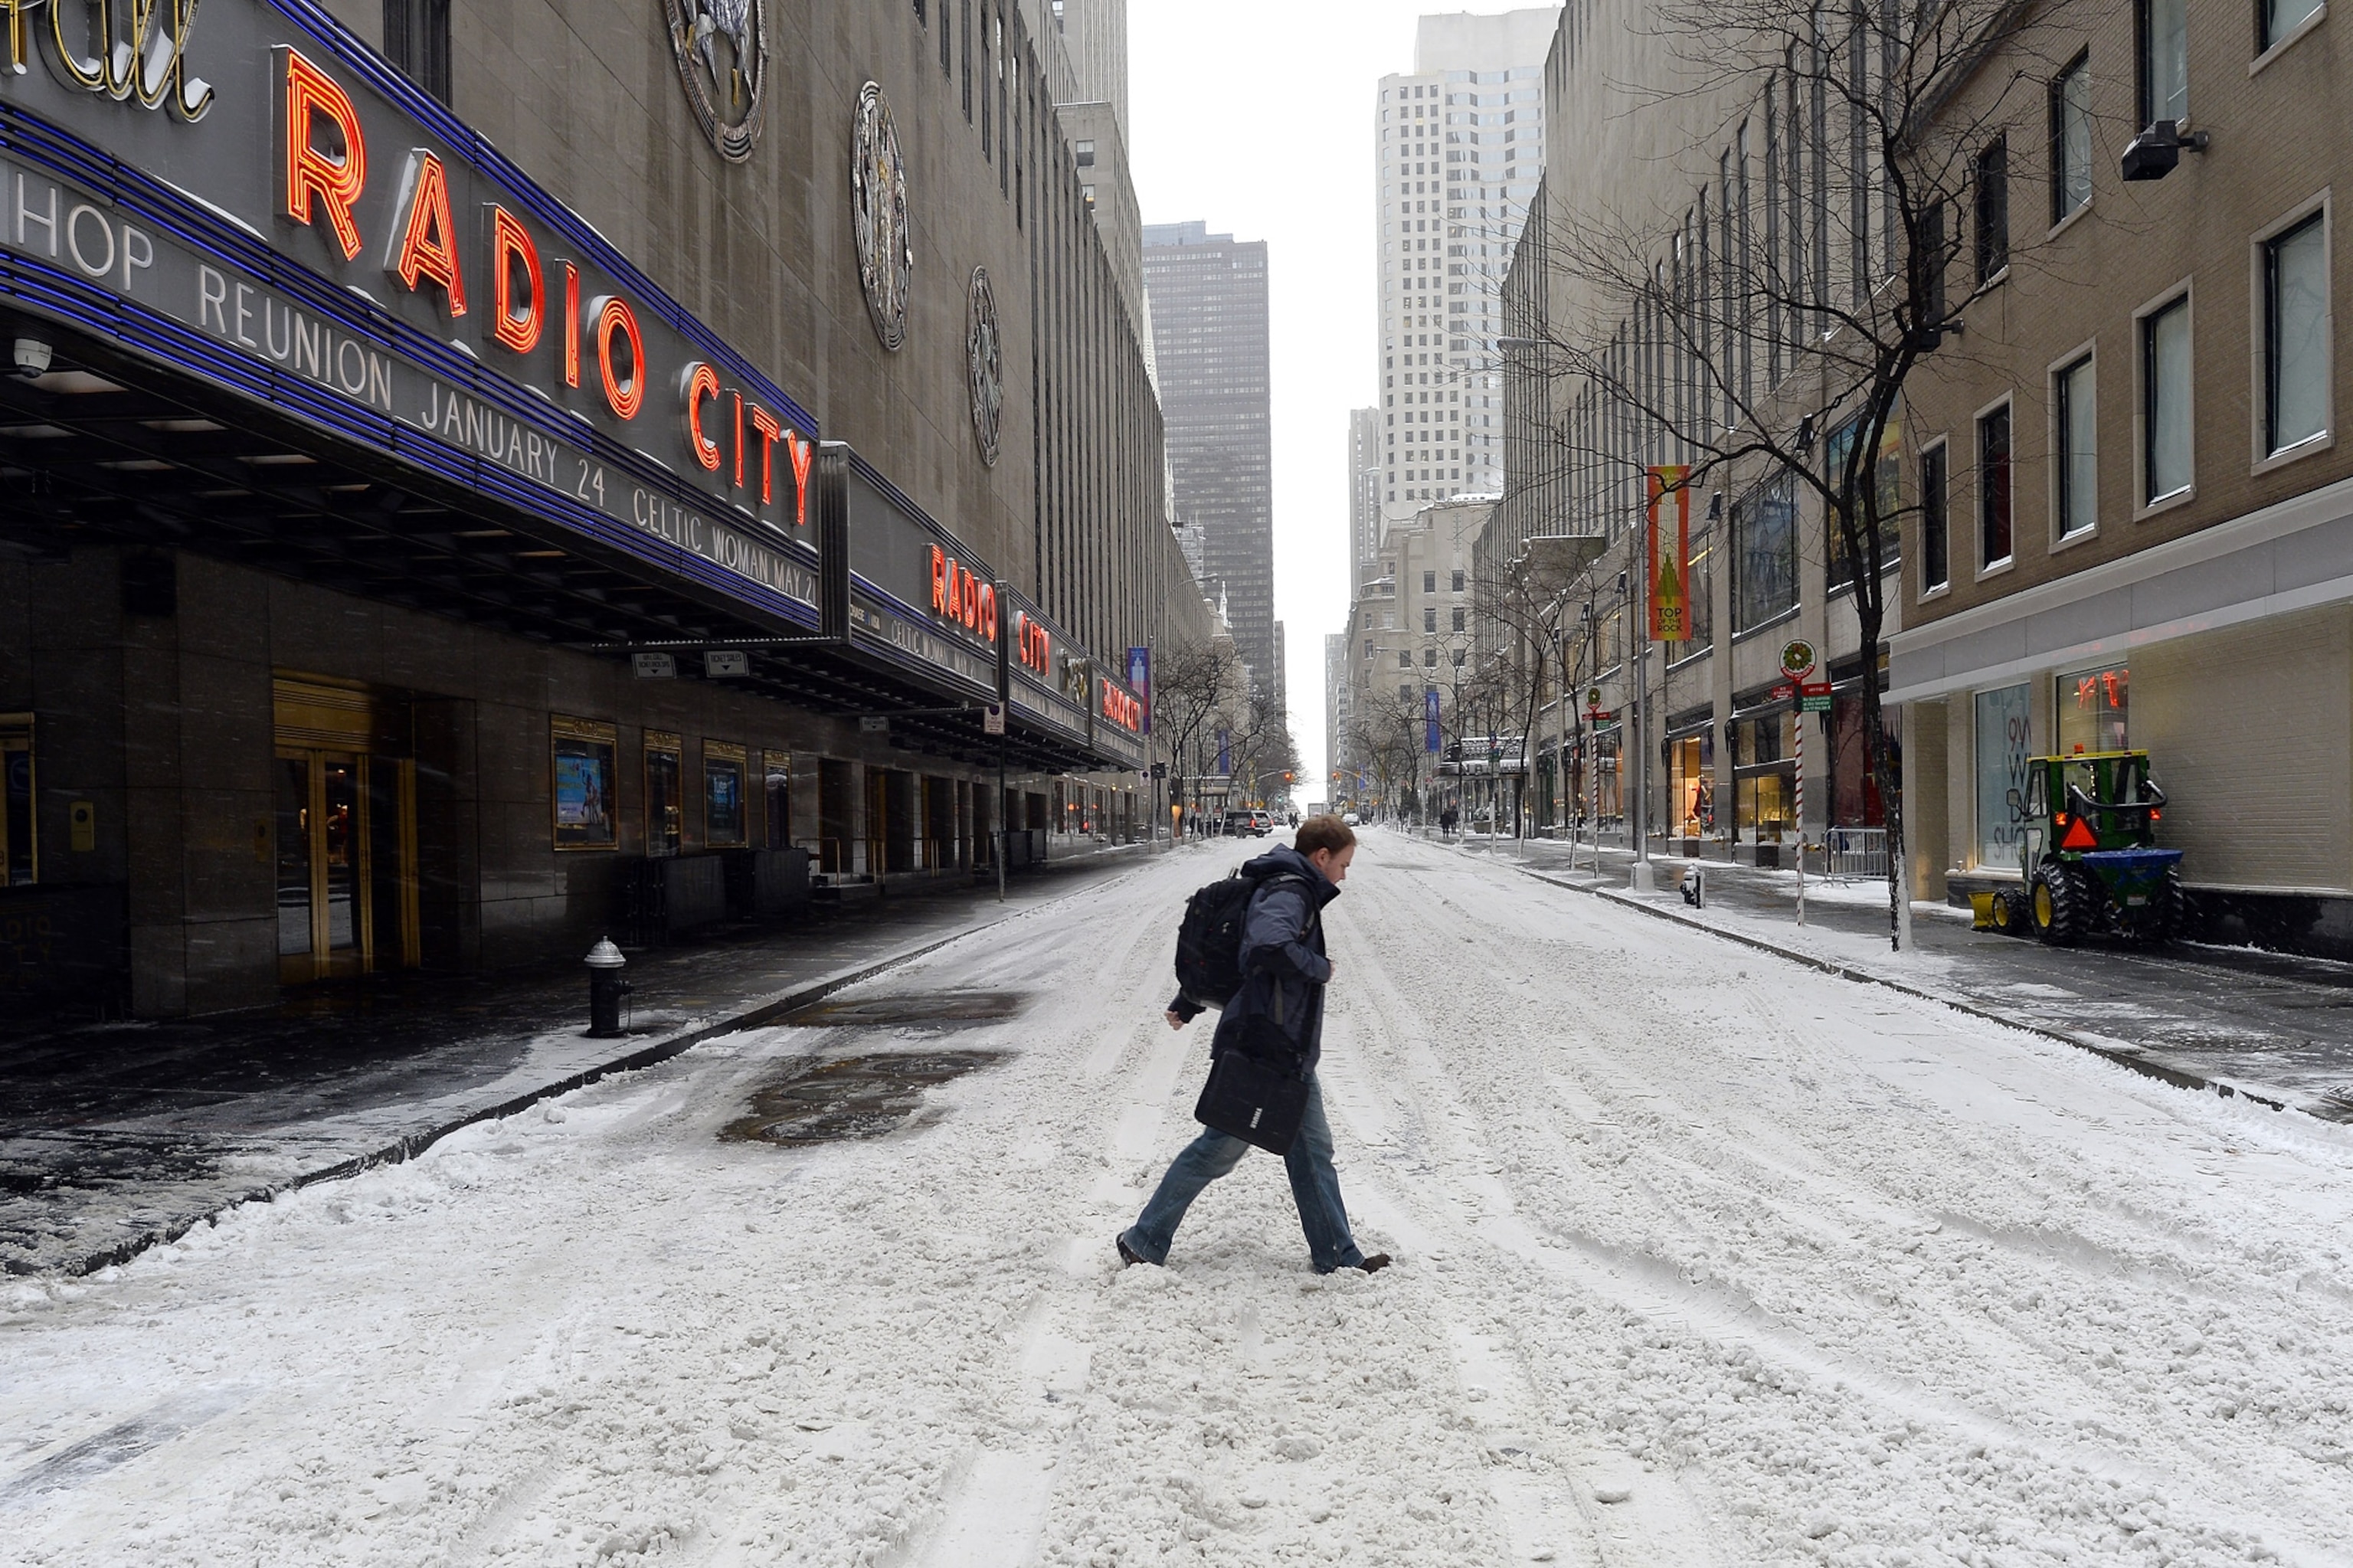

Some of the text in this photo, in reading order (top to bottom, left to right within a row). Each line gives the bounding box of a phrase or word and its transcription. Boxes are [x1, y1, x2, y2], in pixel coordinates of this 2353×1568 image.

[273, 44, 813, 526] RADIO CITY
[15, 172, 817, 606] HOP REUNION JANUARY 24 CELTIC WOMAN MAY 21
[891, 619, 920, 654] CELTIC
[931, 544, 996, 643] RADIO
[1018, 612, 1050, 677] CITY
[1657, 607, 1682, 617] TOP
